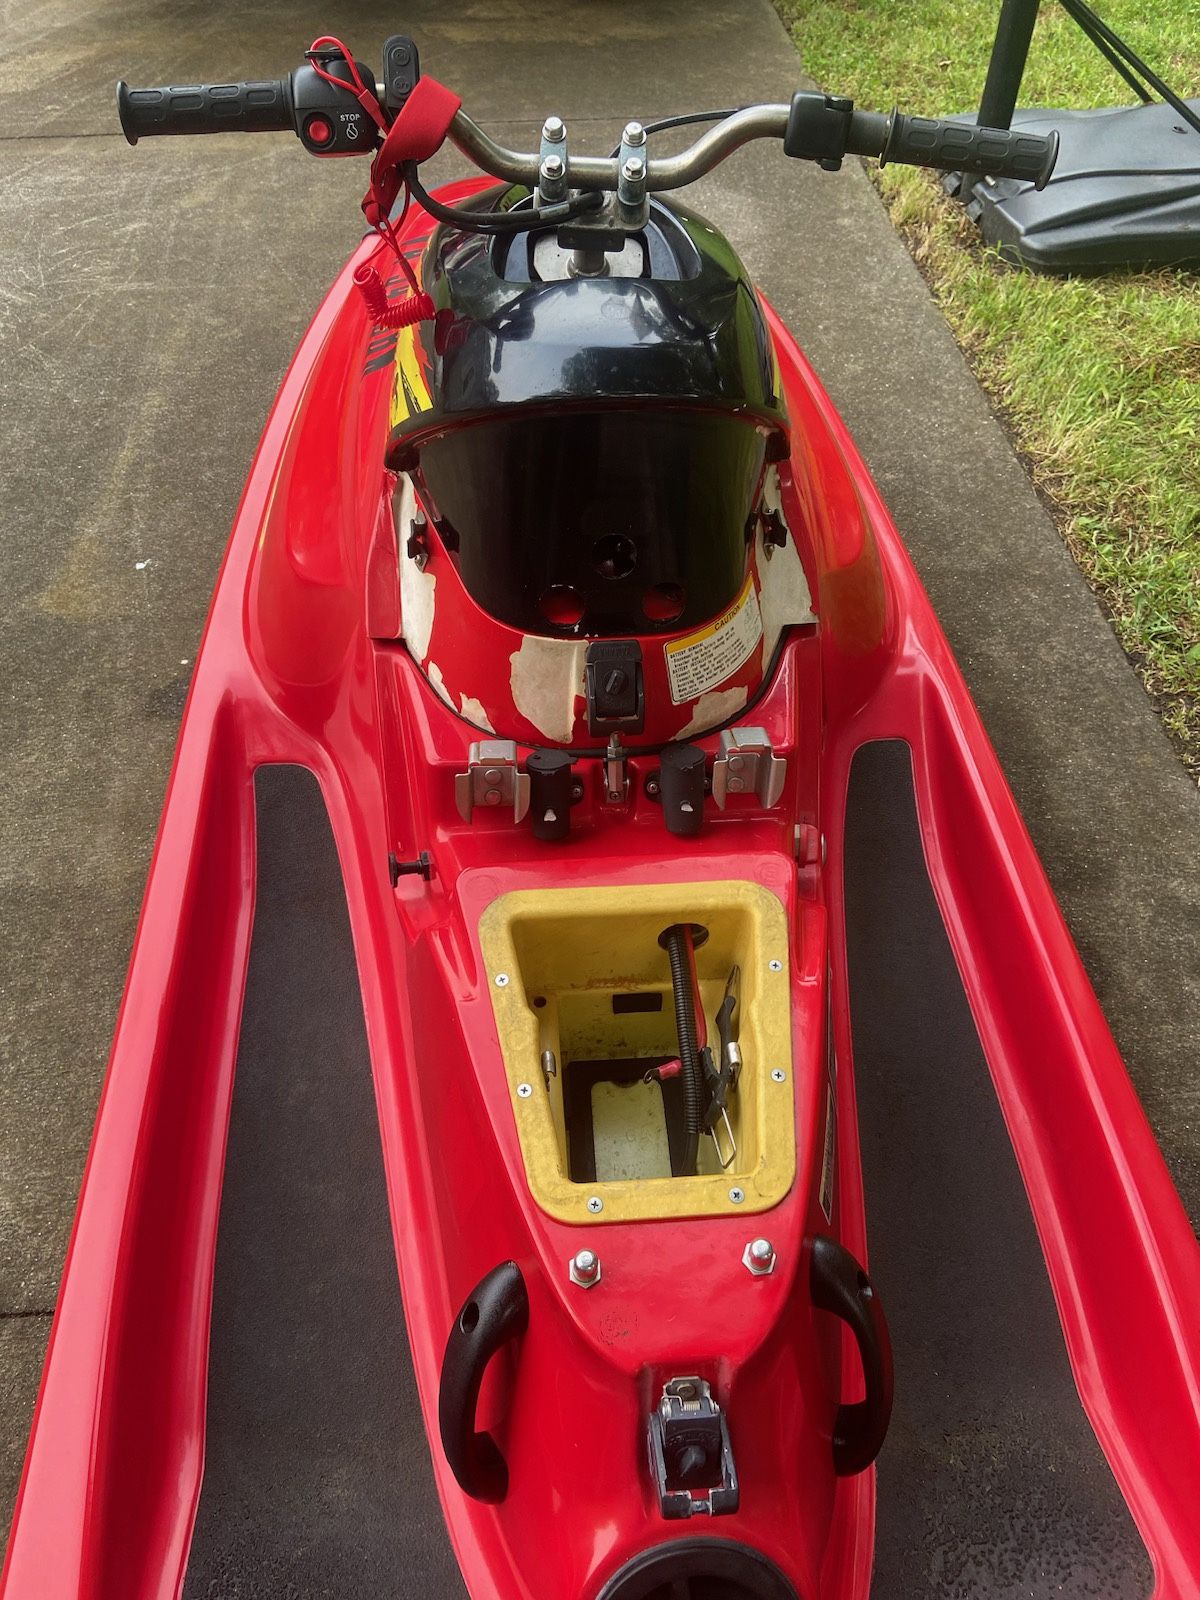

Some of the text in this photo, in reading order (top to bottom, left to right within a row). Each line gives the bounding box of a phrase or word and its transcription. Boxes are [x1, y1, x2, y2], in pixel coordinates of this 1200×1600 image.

[340, 113, 361, 122] STOP
[714, 604, 741, 631] CAUTION
[670, 650, 687, 659] BATTERY
[672, 665, 688, 674] BATTERY
